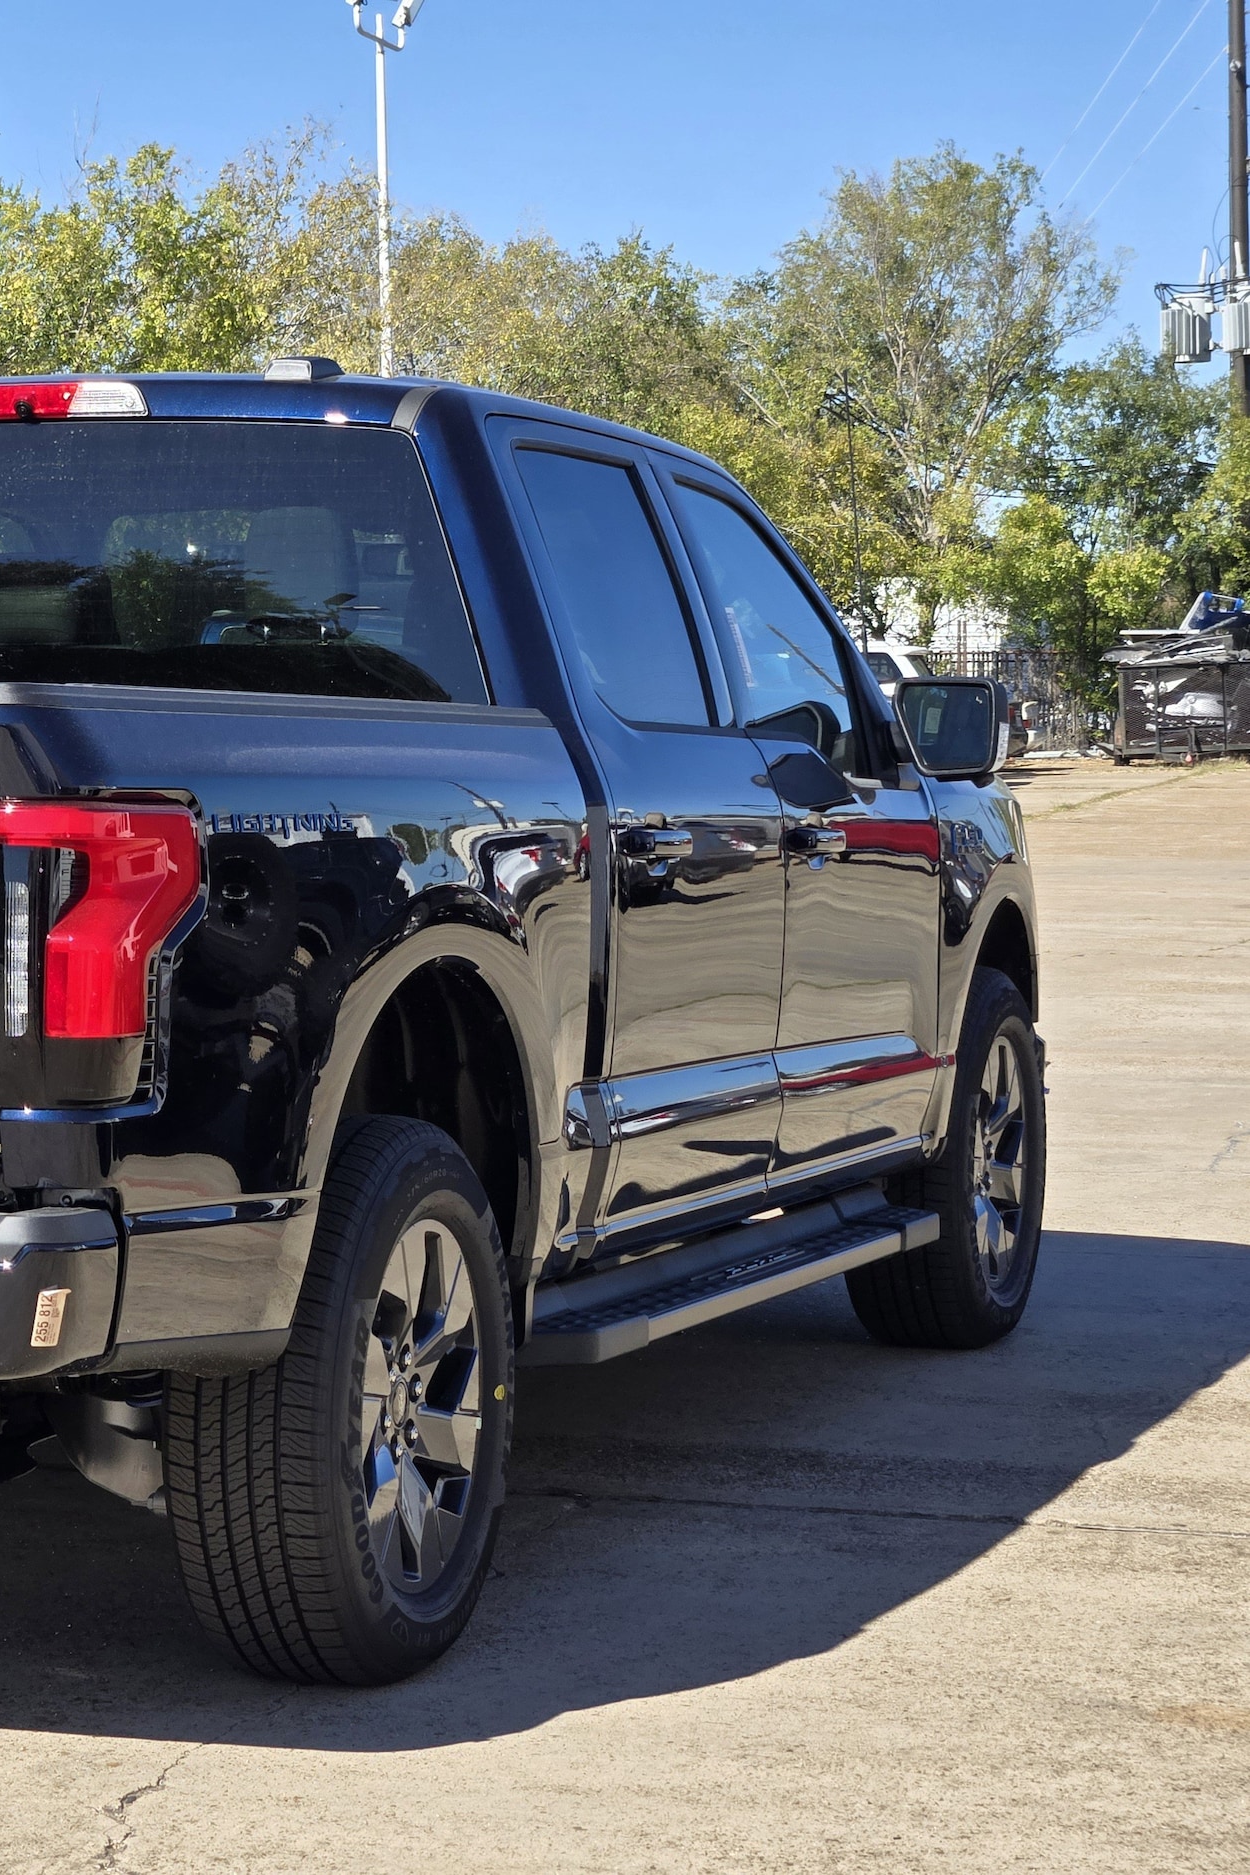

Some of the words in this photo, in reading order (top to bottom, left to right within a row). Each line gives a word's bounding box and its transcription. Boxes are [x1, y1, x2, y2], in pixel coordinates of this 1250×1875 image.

[210, 813, 355, 839] LIGHTNING
[38, 1294, 53, 1317] 812
[34, 1321, 49, 1343] 255
[346, 1317, 384, 1604] GOODYEAR
